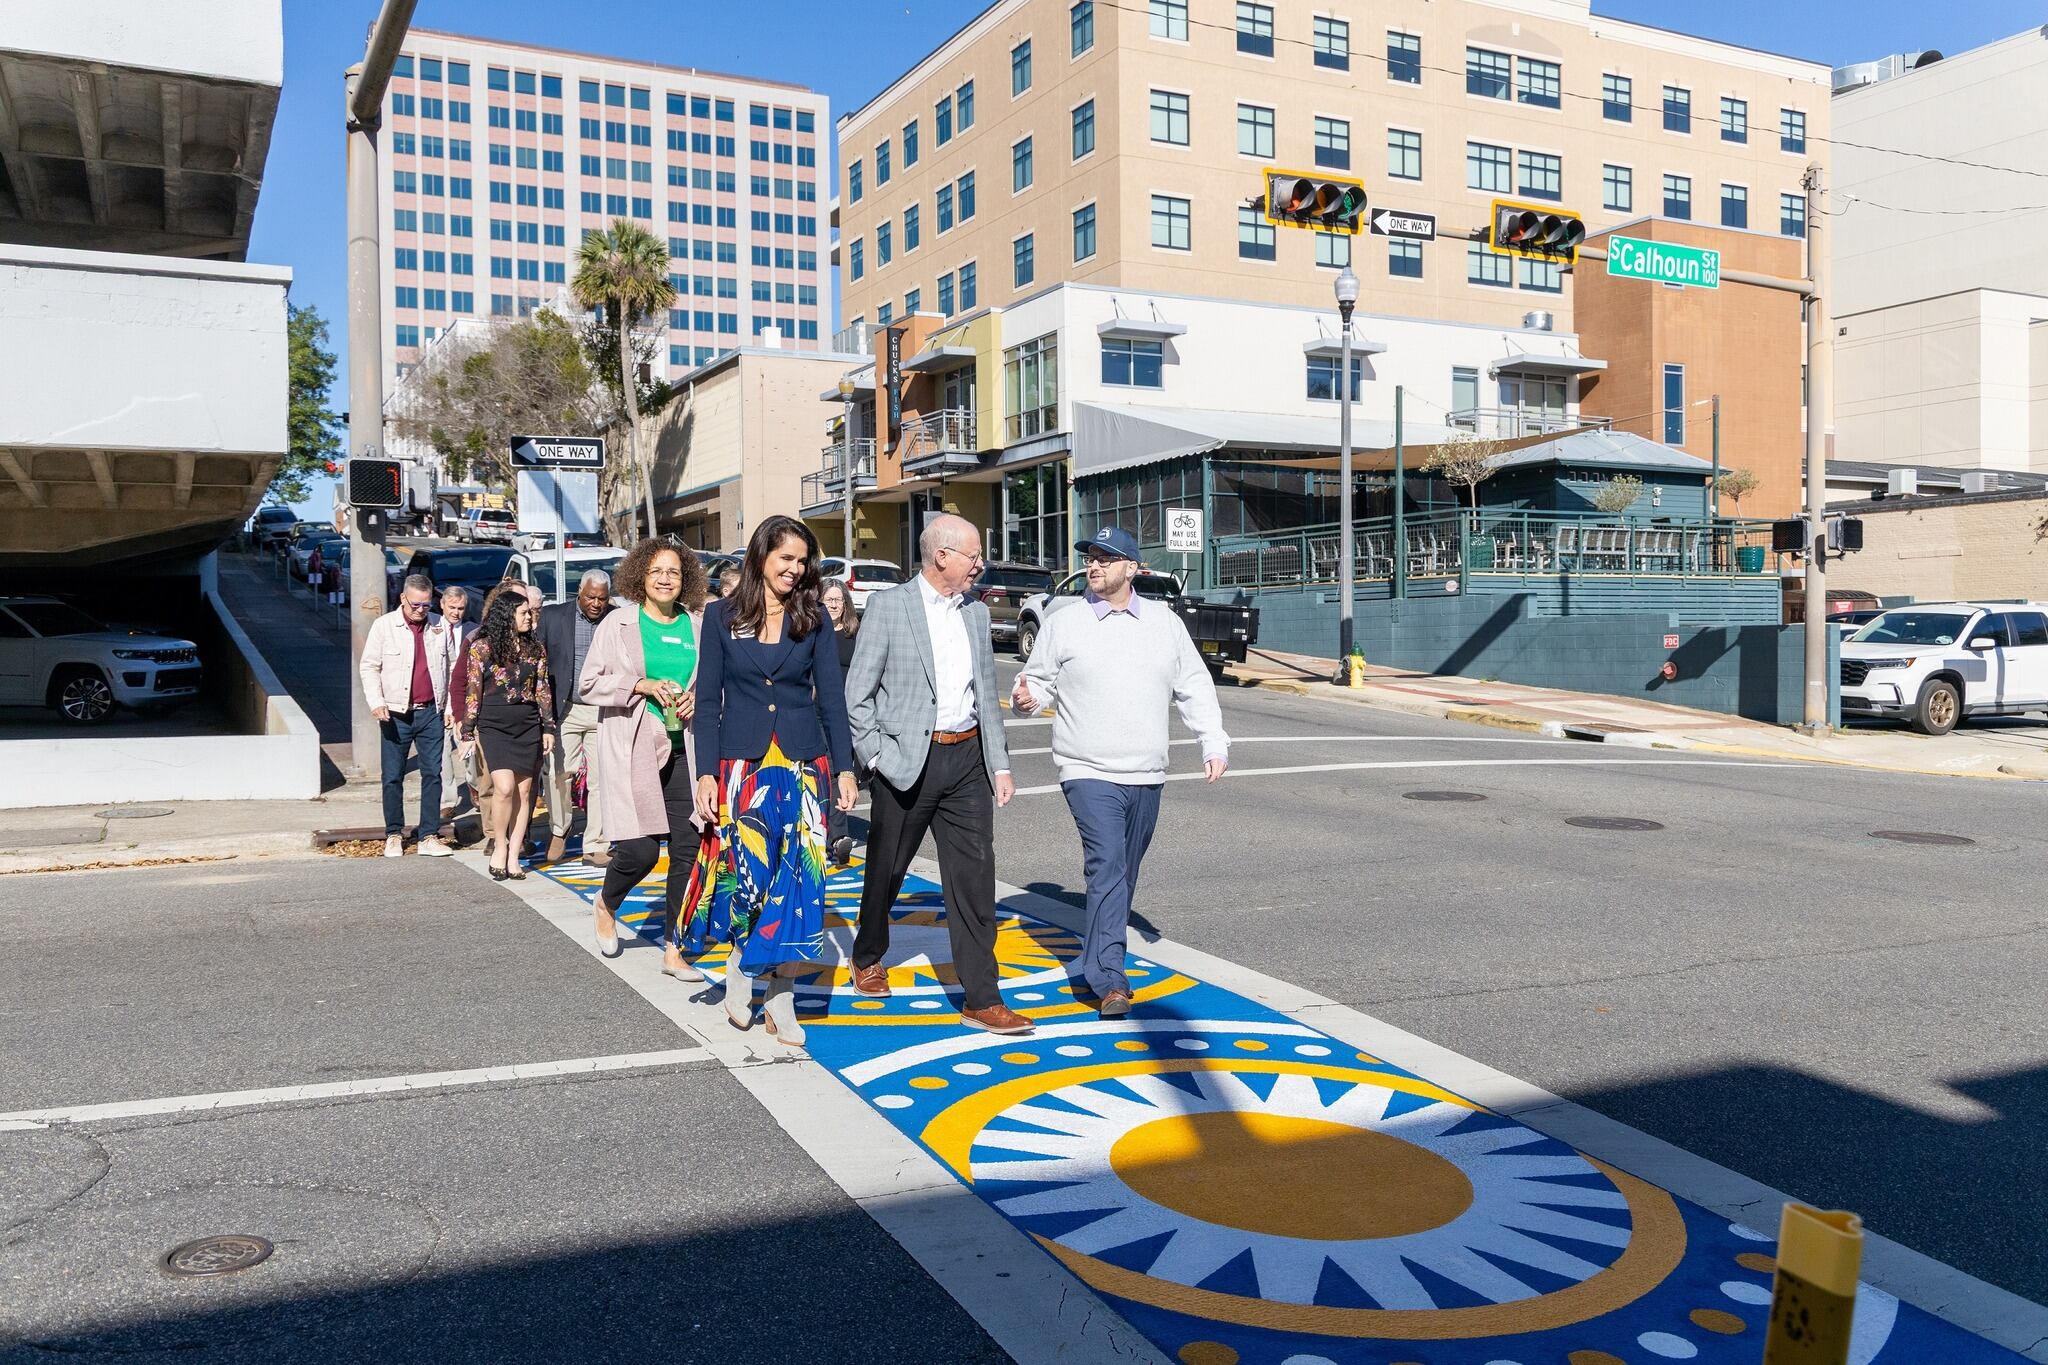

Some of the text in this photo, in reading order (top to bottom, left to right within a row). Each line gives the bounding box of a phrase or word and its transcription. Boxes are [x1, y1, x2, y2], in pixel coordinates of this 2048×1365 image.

[1390, 218, 1429, 233] ONE WAY
[1610, 238, 1717, 281] S Calhoun St
[1702, 269, 1717, 285] 100
[538, 445, 594, 459] ONE WAY
[1186, 530, 1197, 538] USE
[1185, 540, 1200, 548] LANE
